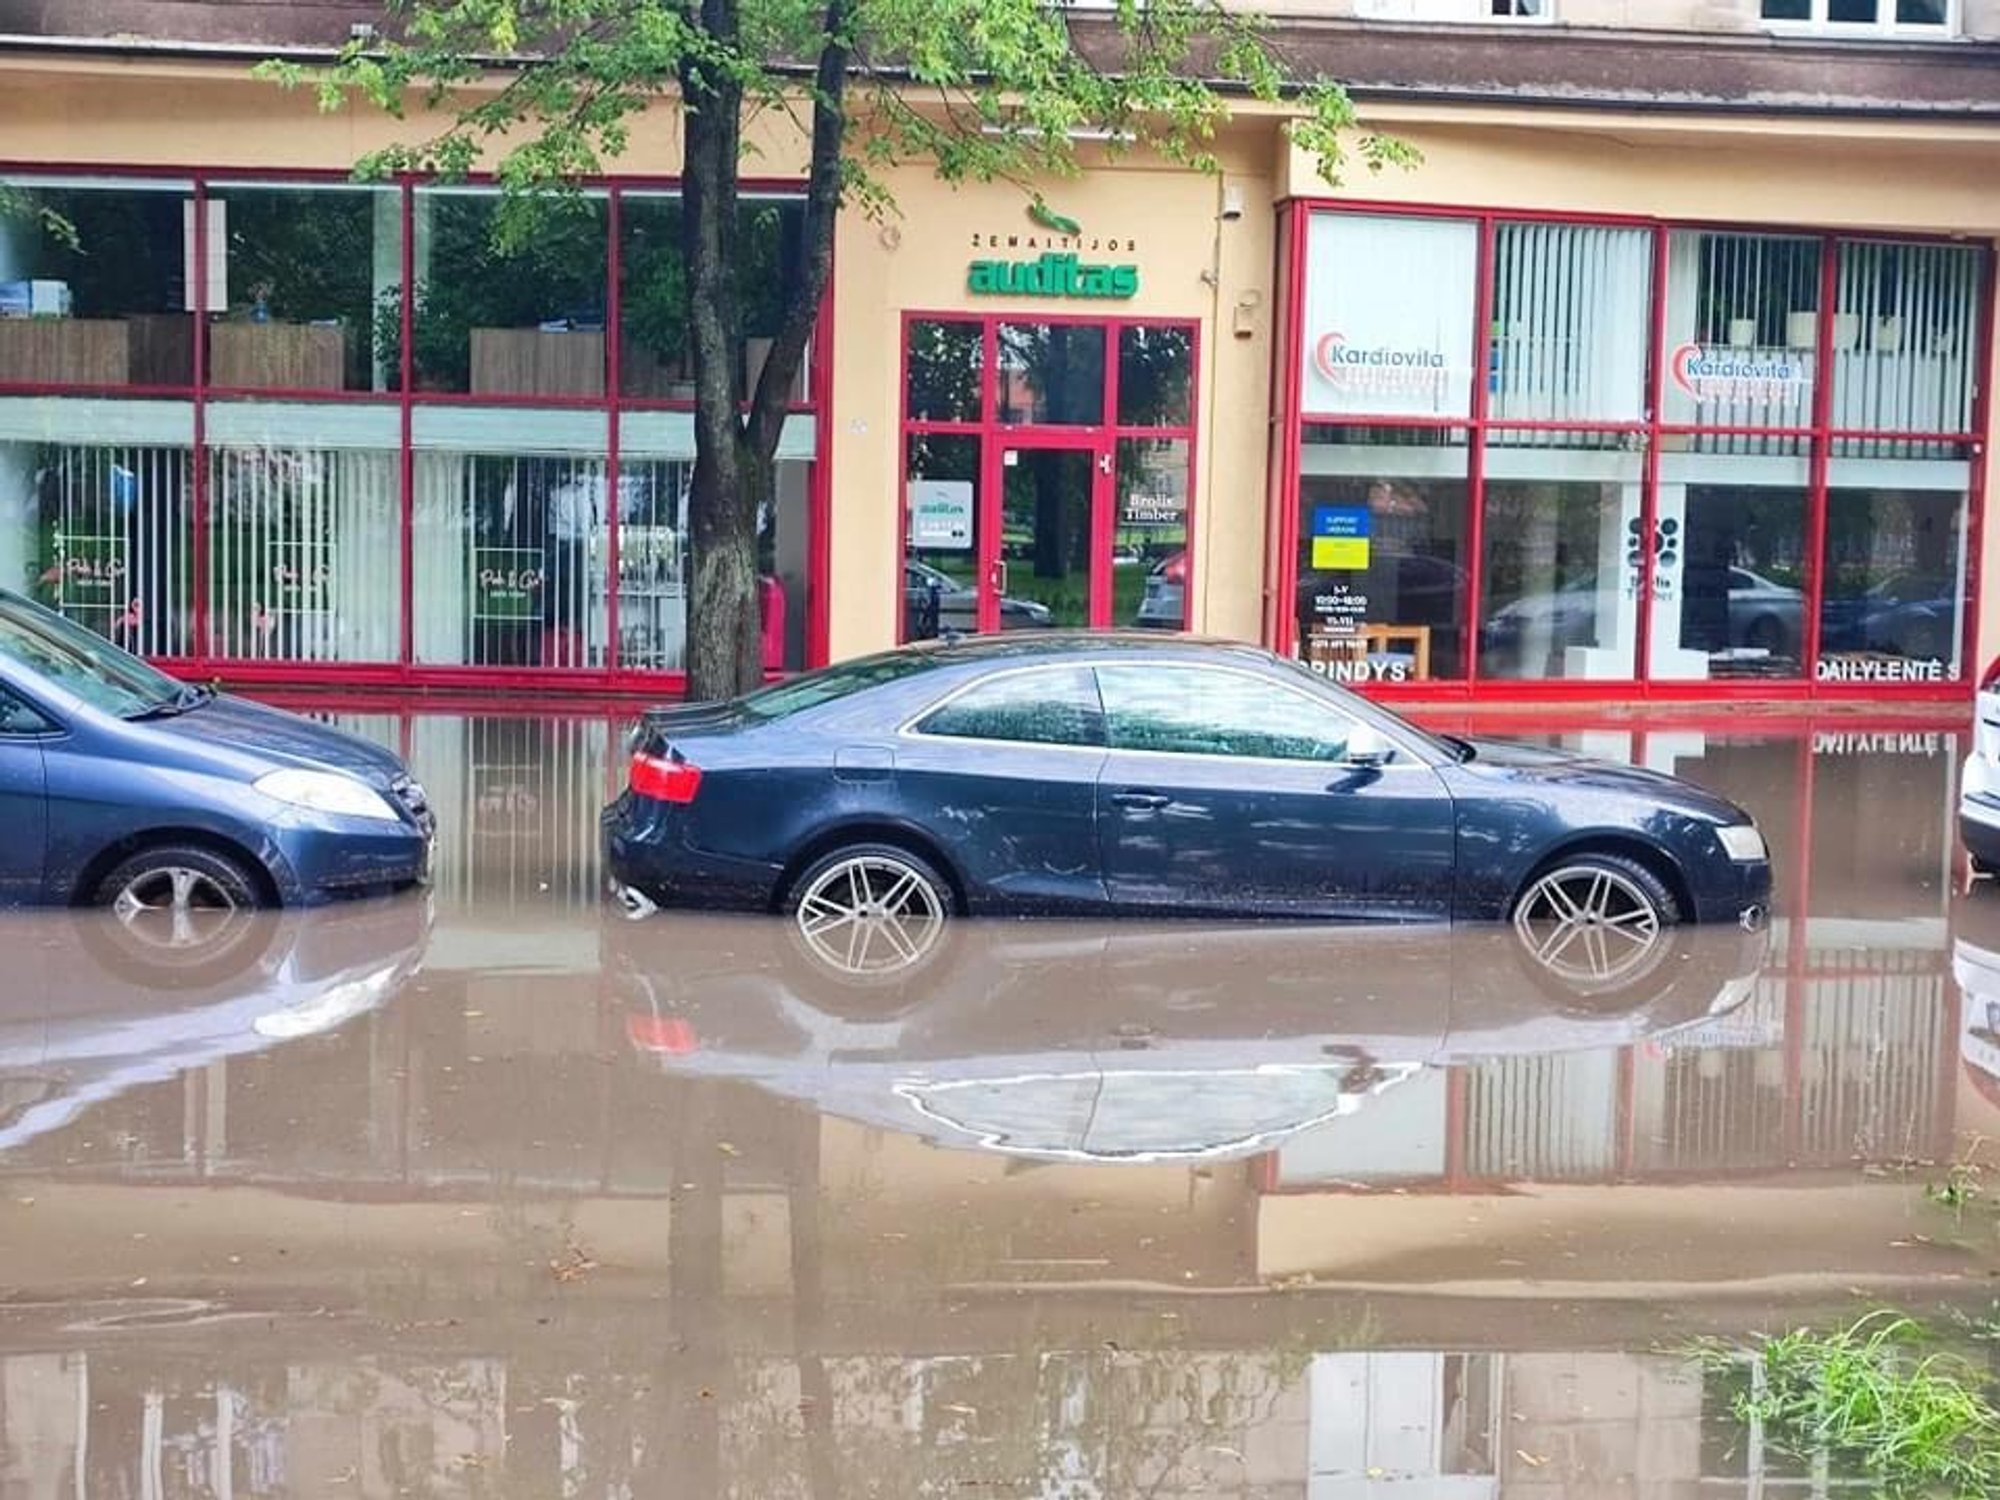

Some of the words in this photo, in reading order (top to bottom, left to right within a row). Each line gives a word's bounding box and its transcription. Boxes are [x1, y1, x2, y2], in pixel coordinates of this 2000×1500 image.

[972, 233, 1135, 252] ŽEMAITIJOS
[968, 252, 1138, 299] auditas
[1332, 345, 1443, 368] Kardiovila
[1687, 357, 1790, 380] Kardiovila
[1125, 508, 1179, 521] Timber
